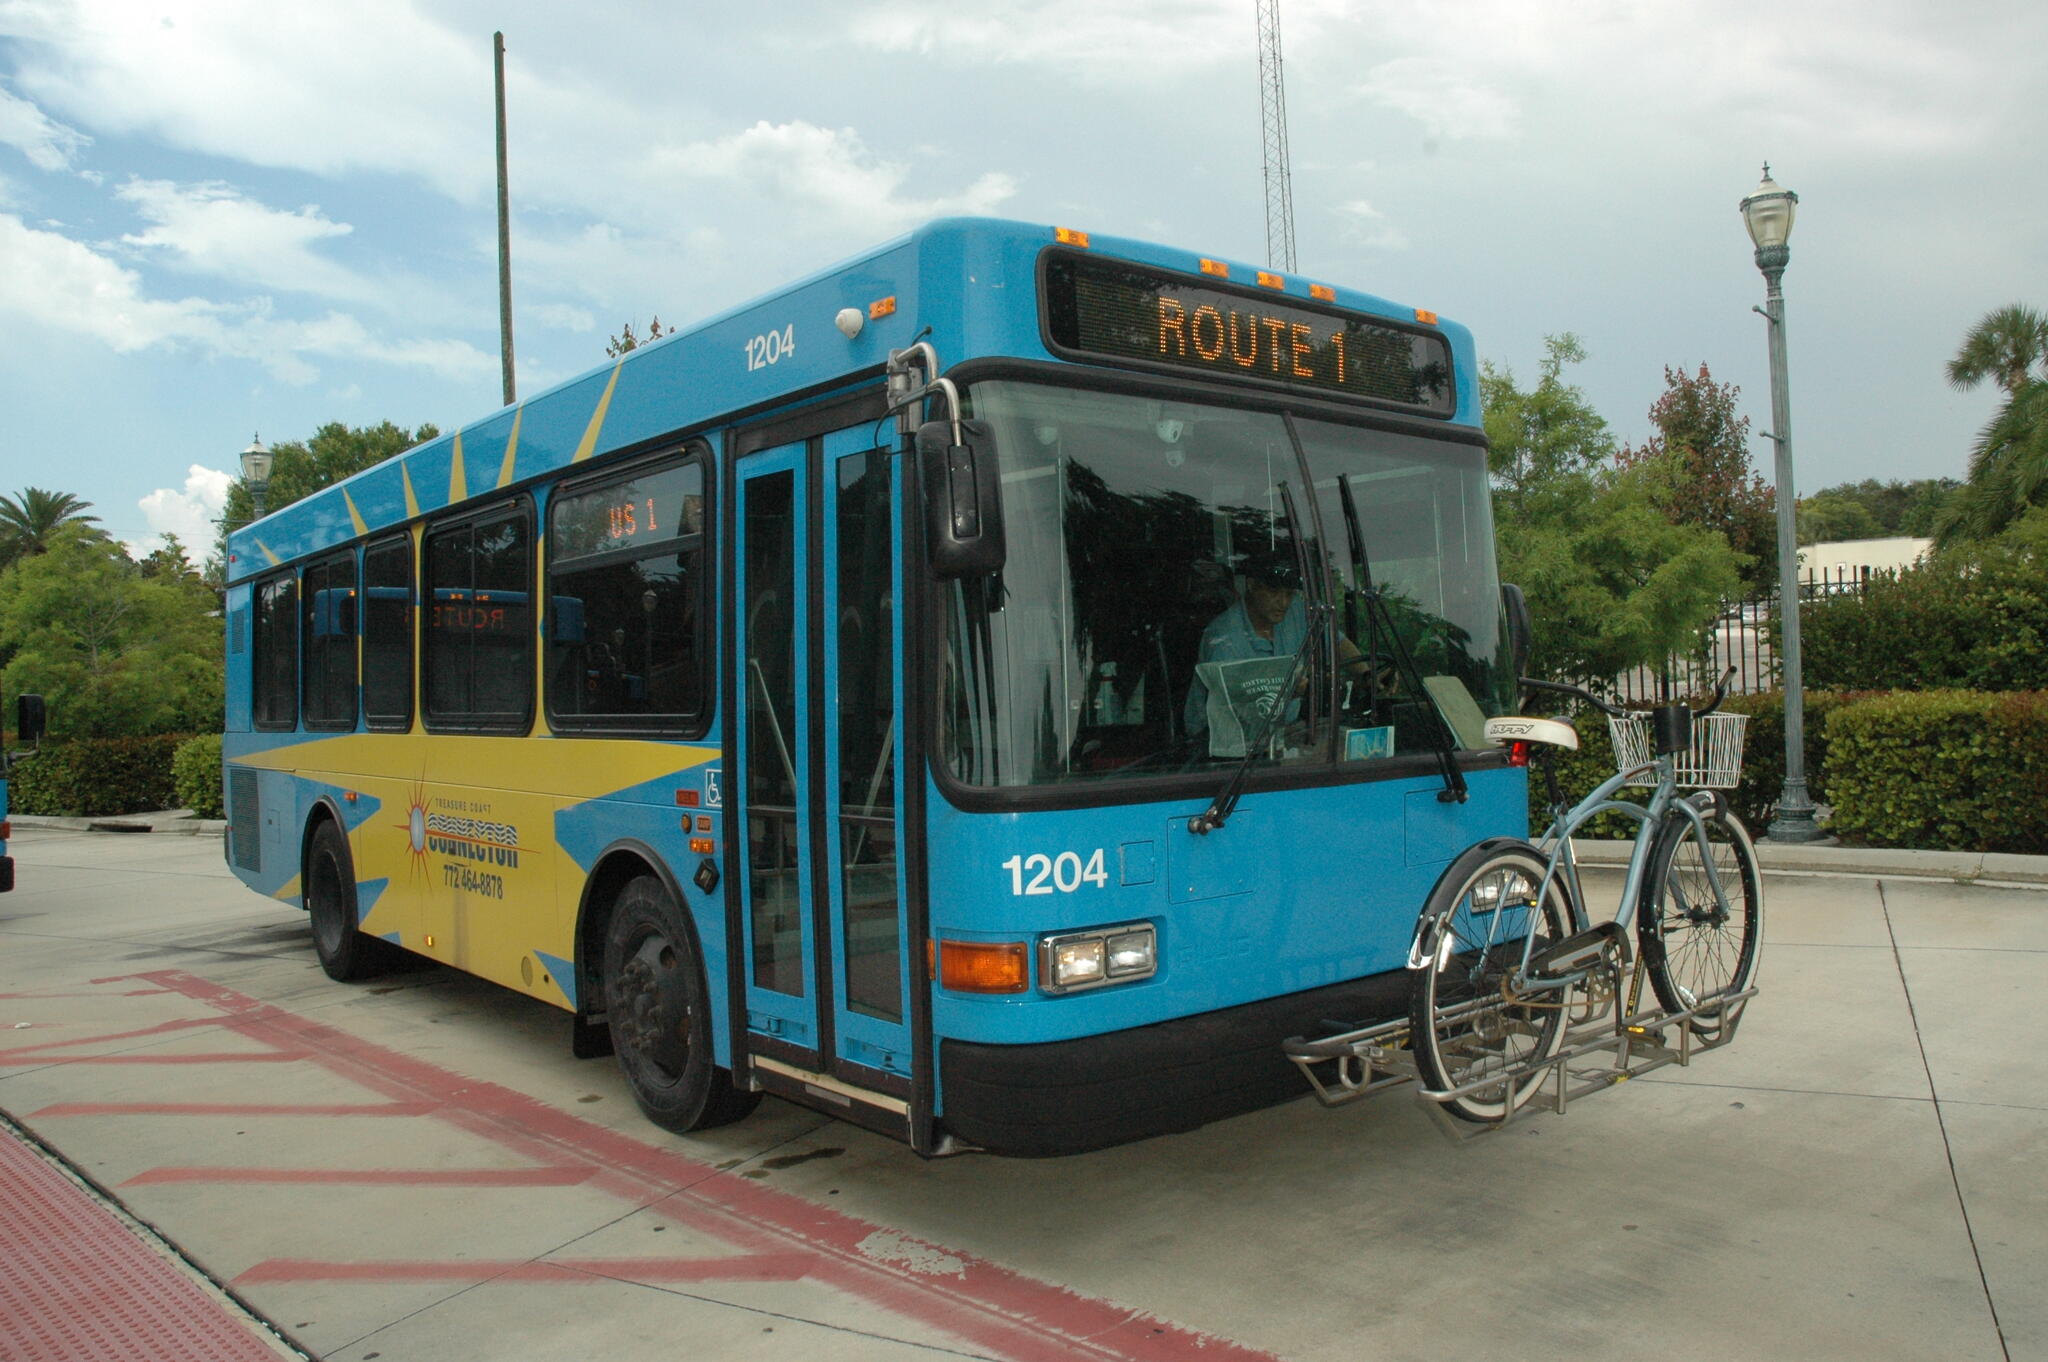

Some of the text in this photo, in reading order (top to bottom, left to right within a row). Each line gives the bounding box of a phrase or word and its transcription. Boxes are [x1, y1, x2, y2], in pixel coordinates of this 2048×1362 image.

[744, 323, 796, 372] 1204
[1159, 296, 1345, 383] ROUTE 1
[609, 498, 657, 539] US 1
[435, 798, 492, 815] TREASURE COAST
[443, 864, 504, 900] 772 464-8878
[1002, 848, 1109, 896] 1204
